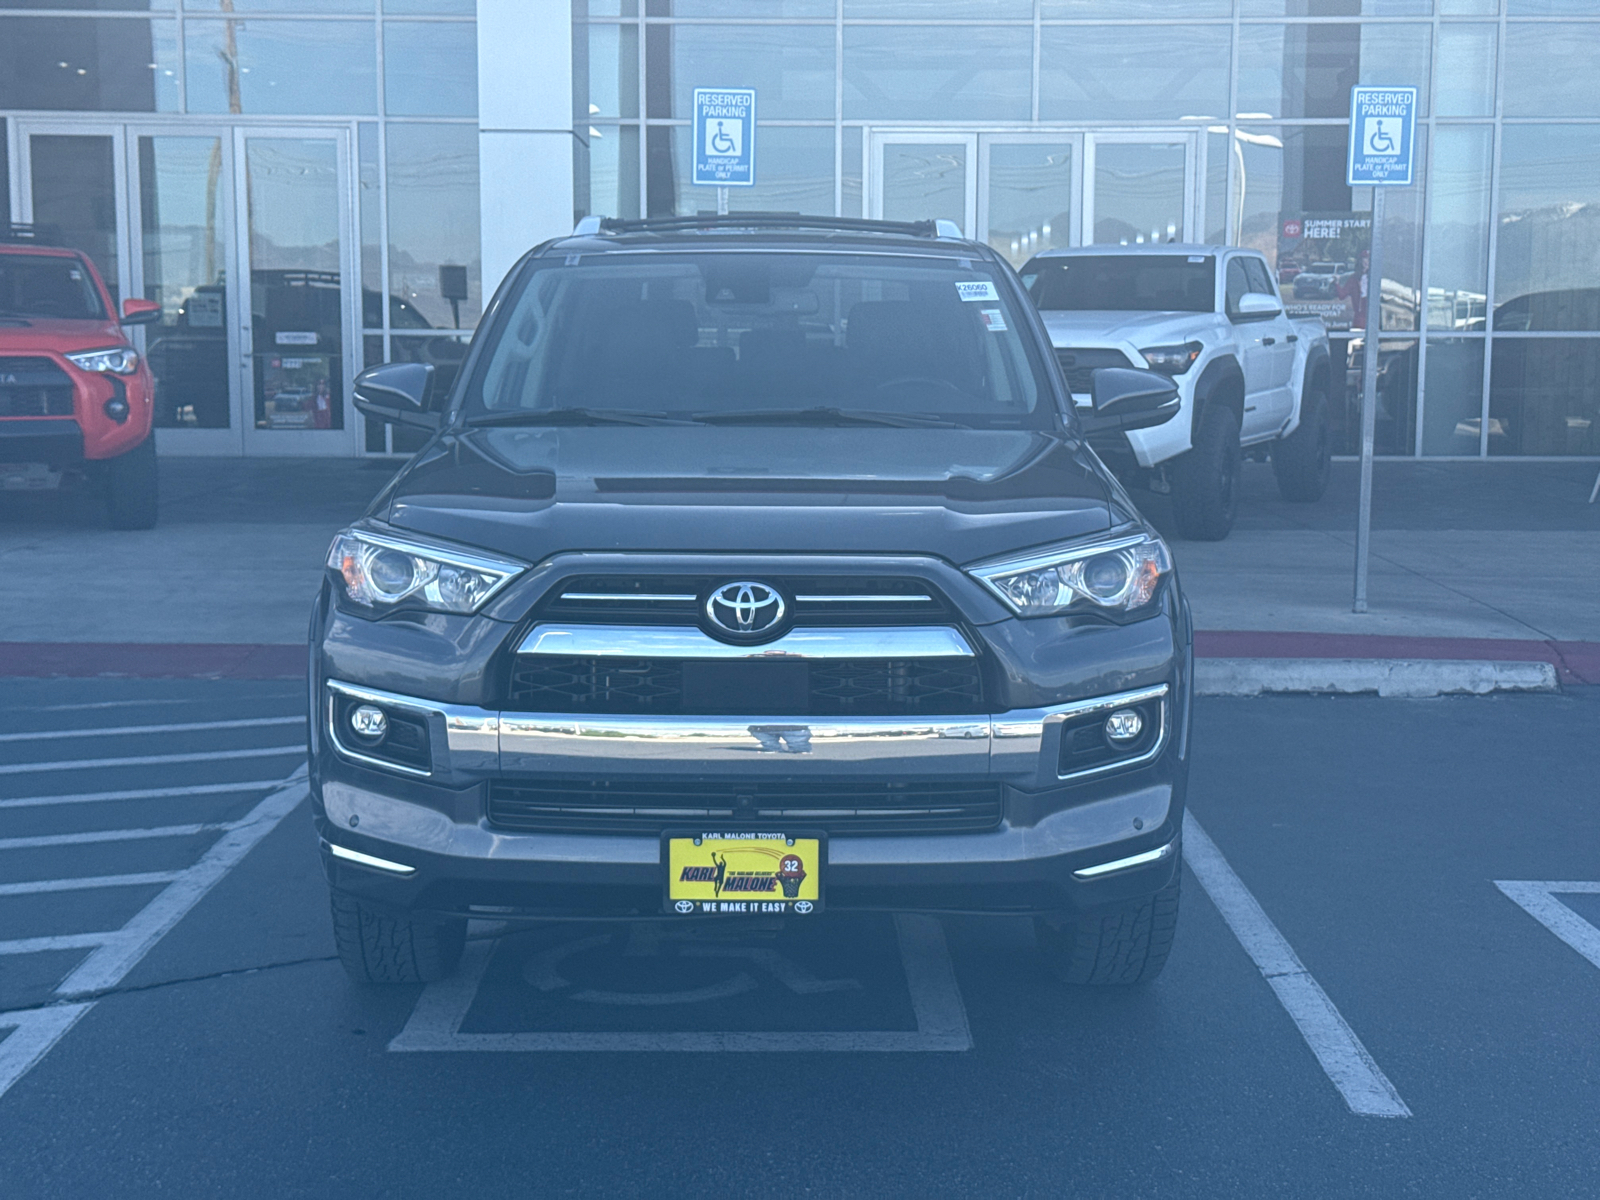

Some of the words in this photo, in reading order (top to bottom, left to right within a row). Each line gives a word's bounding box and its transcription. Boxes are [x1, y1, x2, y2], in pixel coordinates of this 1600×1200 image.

[698, 94, 750, 106] RESERVED
[1358, 92, 1412, 105] RESERVED
[702, 105, 746, 117] PARKING
[1361, 104, 1407, 116] PARKING
[707, 157, 740, 165] HANDICAP
[1364, 156, 1398, 164] HANDICAP
[698, 164, 716, 172] PLATE
[725, 164, 749, 172] PERMIT
[1354, 163, 1374, 171] PLATE
[1383, 163, 1407, 171] PERMIT
[715, 171, 731, 179] ONLY
[1372, 170, 1389, 178] ONLY
[1304, 219, 1343, 228] SUMMER
[1343, 219, 1371, 229] START
[1303, 227, 1341, 239] HERE!
[701, 832, 722, 840] KARL
[724, 832, 756, 840] MALONE
[757, 832, 787, 840] TOYOTA
[784, 859, 799, 872] 32
[679, 866, 717, 882] KARL
[722, 875, 777, 892] MALONE
[702, 902, 717, 912] WE
[720, 902, 747, 912] MAKE
[750, 902, 760, 912] IT
[761, 902, 787, 912] EASY
